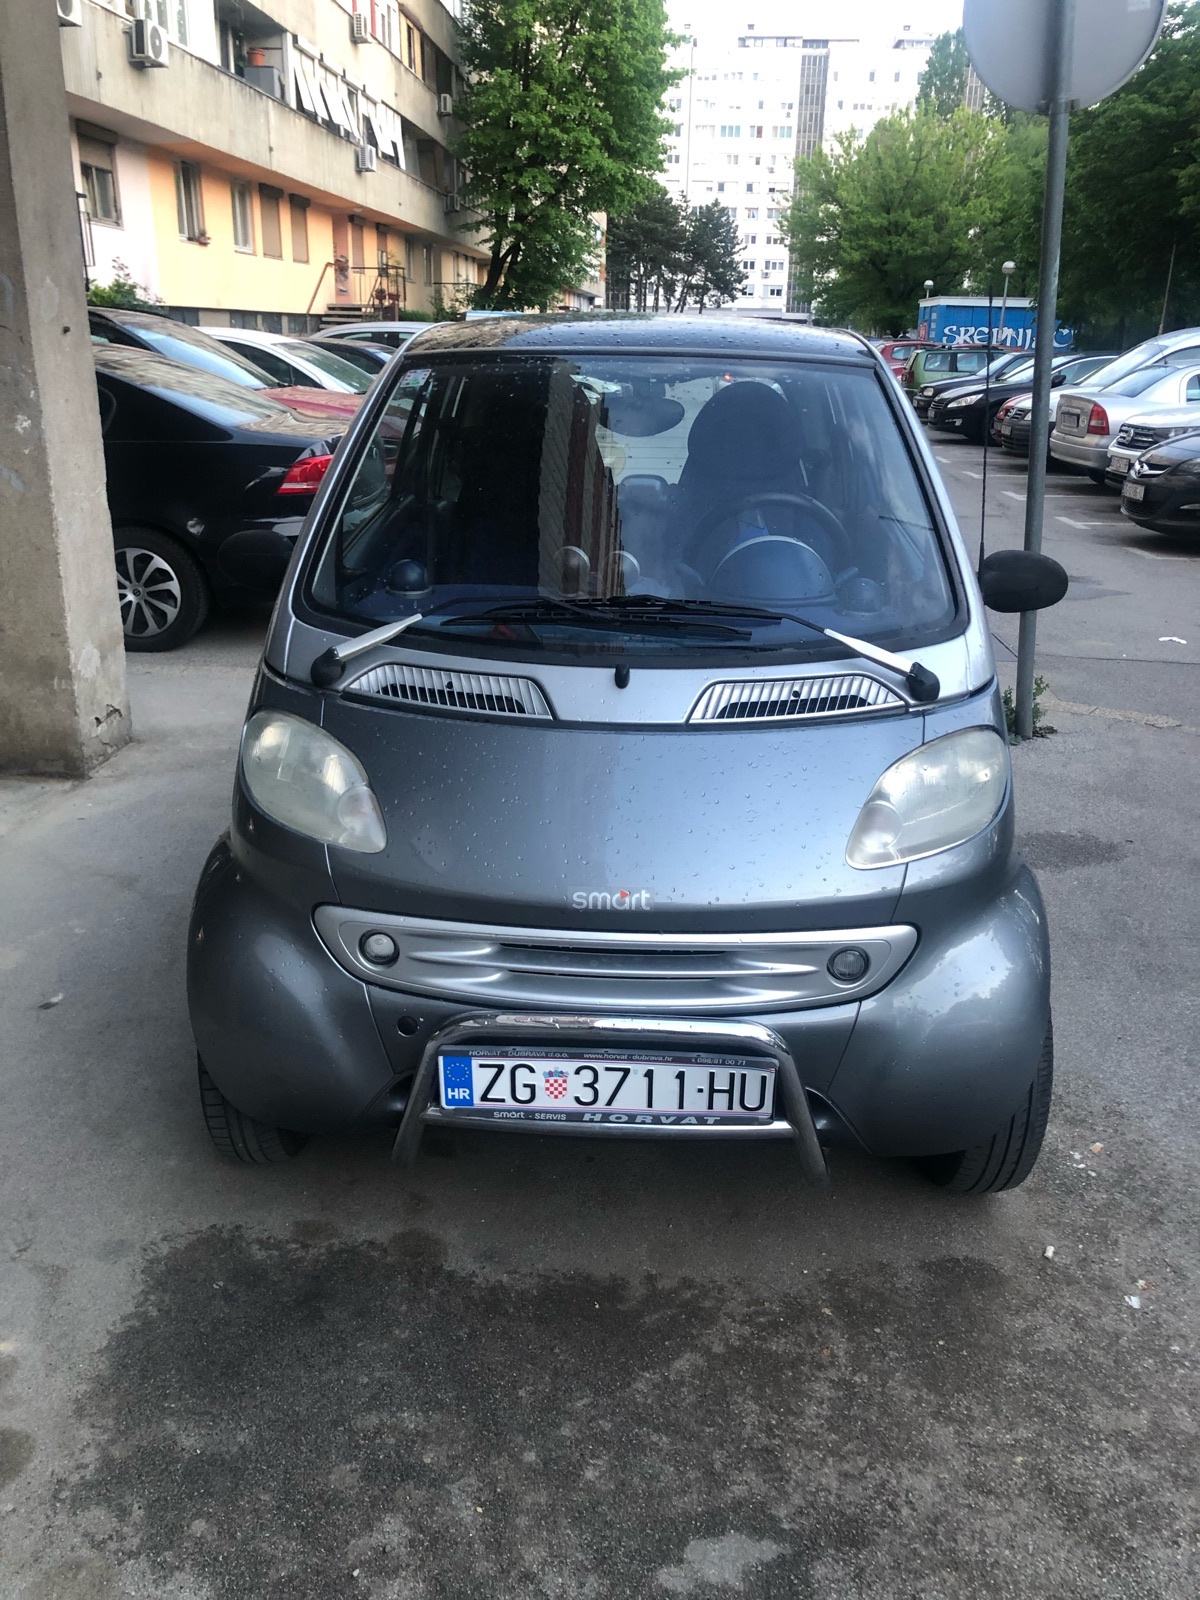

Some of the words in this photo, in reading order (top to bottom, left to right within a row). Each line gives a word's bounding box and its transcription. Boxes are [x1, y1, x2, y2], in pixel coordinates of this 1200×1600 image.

[572, 889, 651, 910] smart
[478, 1063, 536, 1105] ZG
[447, 1087, 470, 1100] HR
[493, 1111, 525, 1120] smart
[535, 1112, 567, 1121] SERVIS
[582, 1112, 721, 1125] HORVAT
